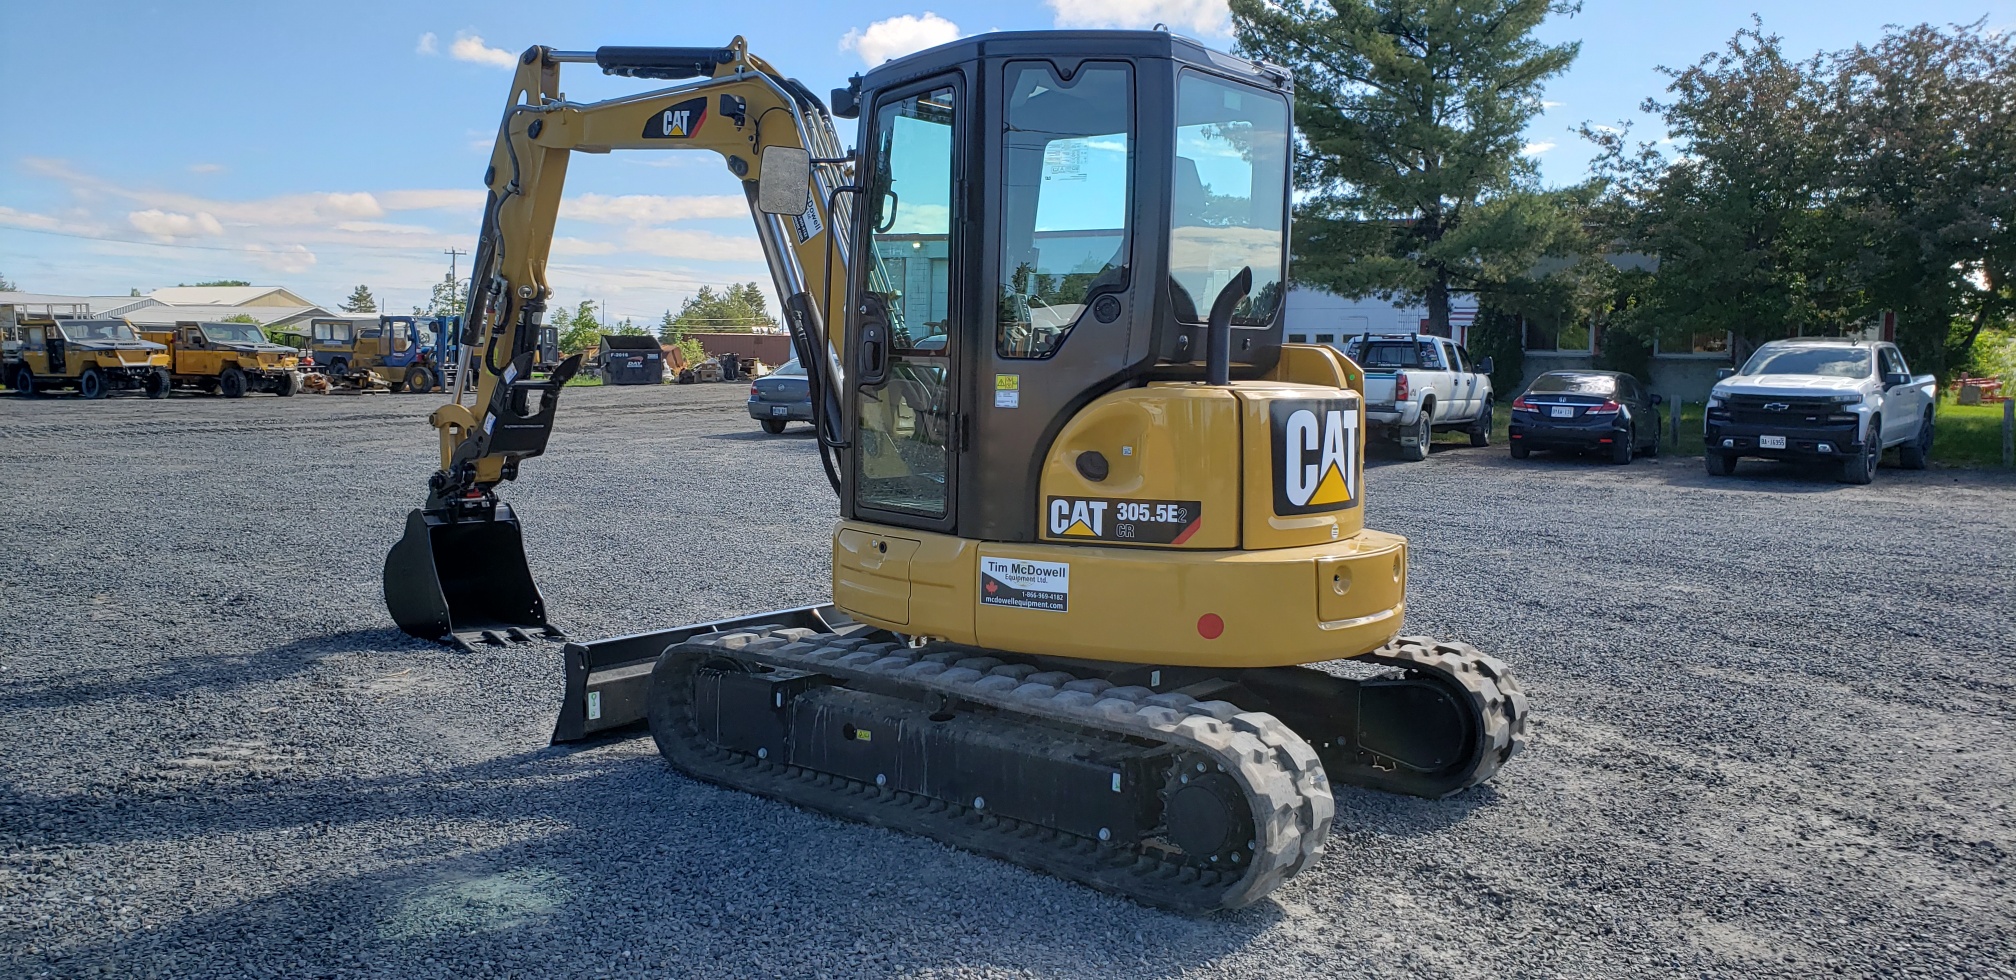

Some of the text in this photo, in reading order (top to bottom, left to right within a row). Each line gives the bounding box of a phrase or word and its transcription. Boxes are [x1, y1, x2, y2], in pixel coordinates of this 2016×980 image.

[662, 110, 690, 136] CAT
[805, 196, 821, 231] Dowell
[1286, 409, 1358, 507] CAT
[1050, 499, 1108, 537] CAT
[1116, 524, 1135, 538] CR
[988, 561, 1066, 578] Tim McDowell
[1004, 573, 1048, 584] Equipment Ltd.
[985, 596, 1064, 610] mcdowellequipment.com
[1021, 591, 1064, 601] 1-866-969-4182
